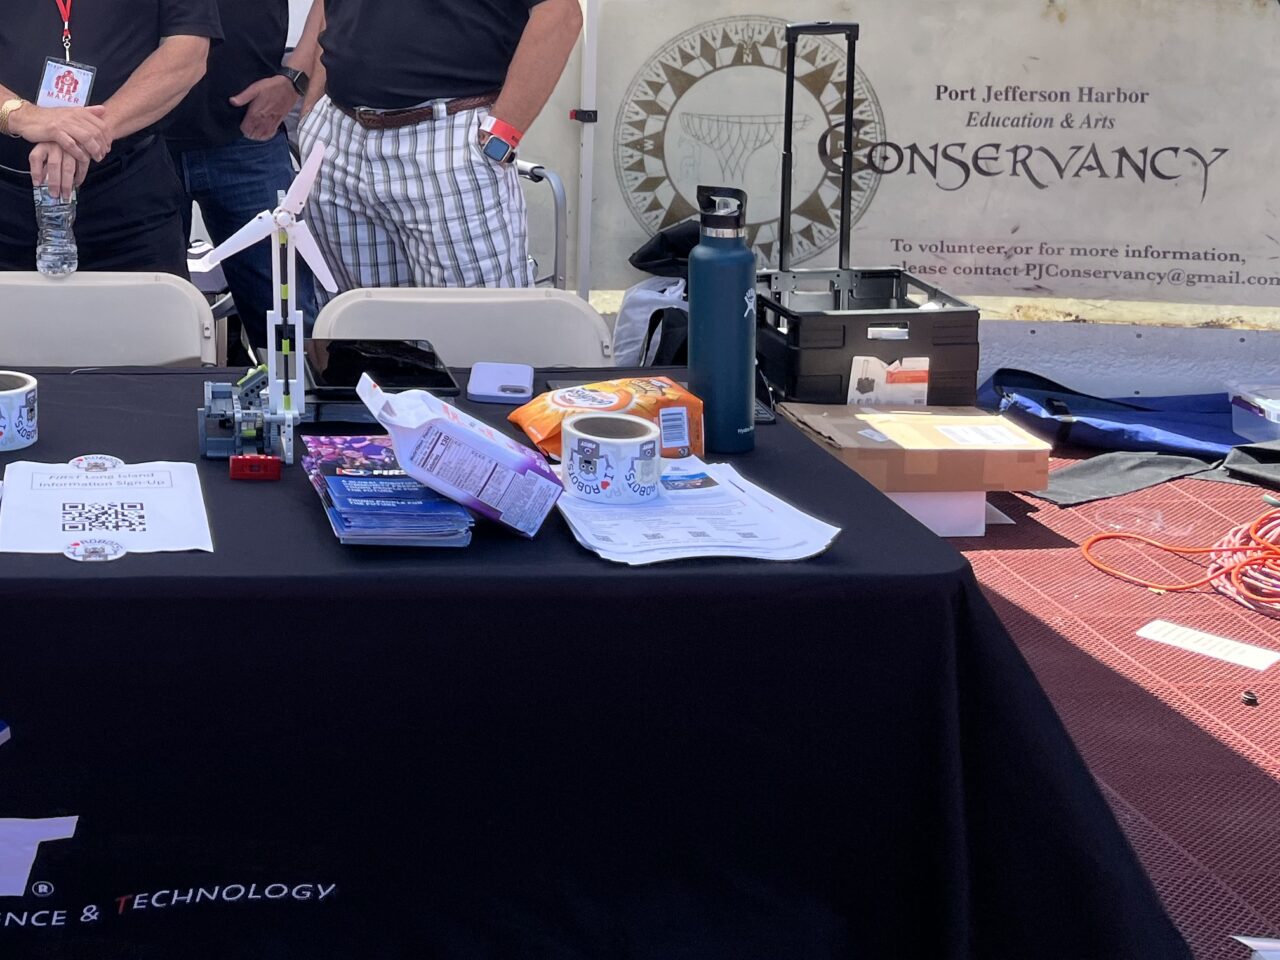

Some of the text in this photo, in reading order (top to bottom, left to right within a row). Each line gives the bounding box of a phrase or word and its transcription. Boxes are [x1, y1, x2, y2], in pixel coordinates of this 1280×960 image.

[743, 54, 752, 63] N
[47, 90, 80, 104] MAKER
[935, 84, 1150, 105] Port Jefferson Harbor
[966, 111, 1116, 130] Education & Arts
[890, 238, 1246, 265] To volunteer, or for more information,
[890, 260, 946, 275] lease
[953, 262, 1019, 277] contact
[567, 463, 601, 495] ROBOTS
[80, 904, 99, 923] &
[115, 881, 337, 916] TECHNOLOGY
